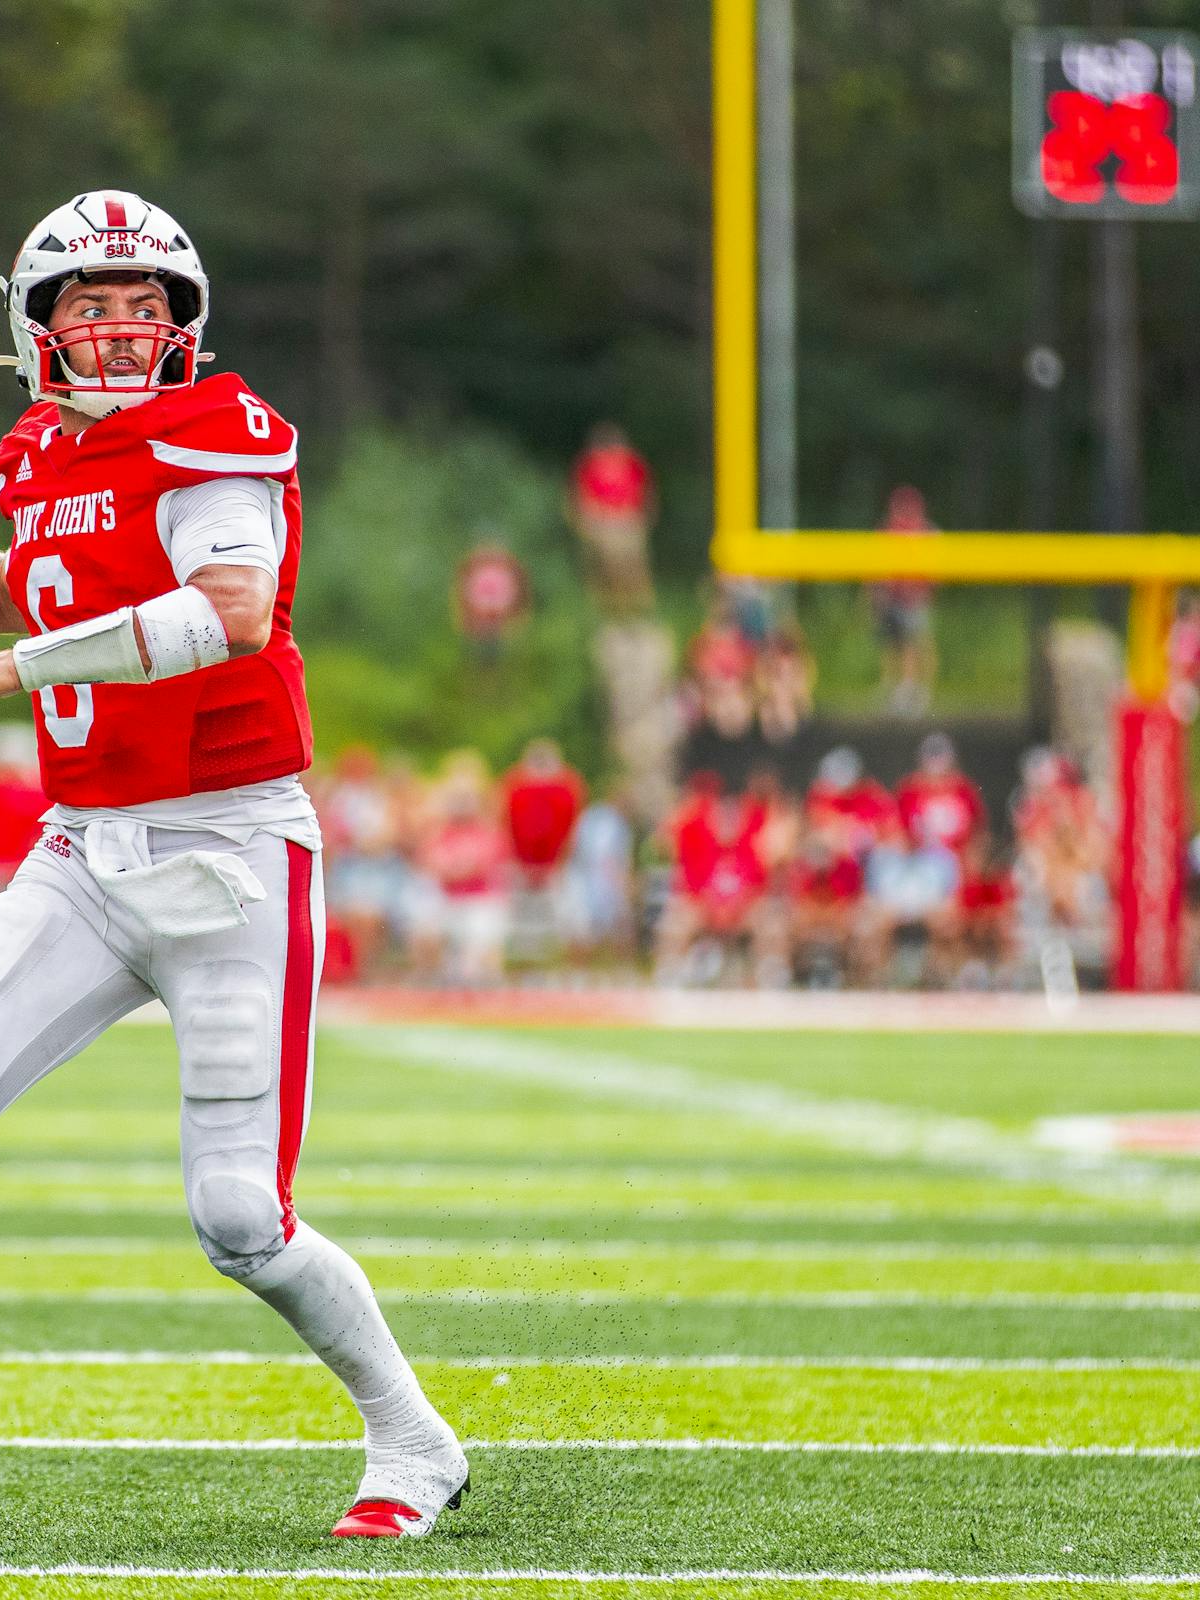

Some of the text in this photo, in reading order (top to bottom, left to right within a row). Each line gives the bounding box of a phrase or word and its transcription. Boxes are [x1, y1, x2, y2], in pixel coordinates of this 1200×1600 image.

[105, 242, 136, 257] SJU
[237, 391, 271, 439] 6
[44, 489, 116, 538] JOHN'S
